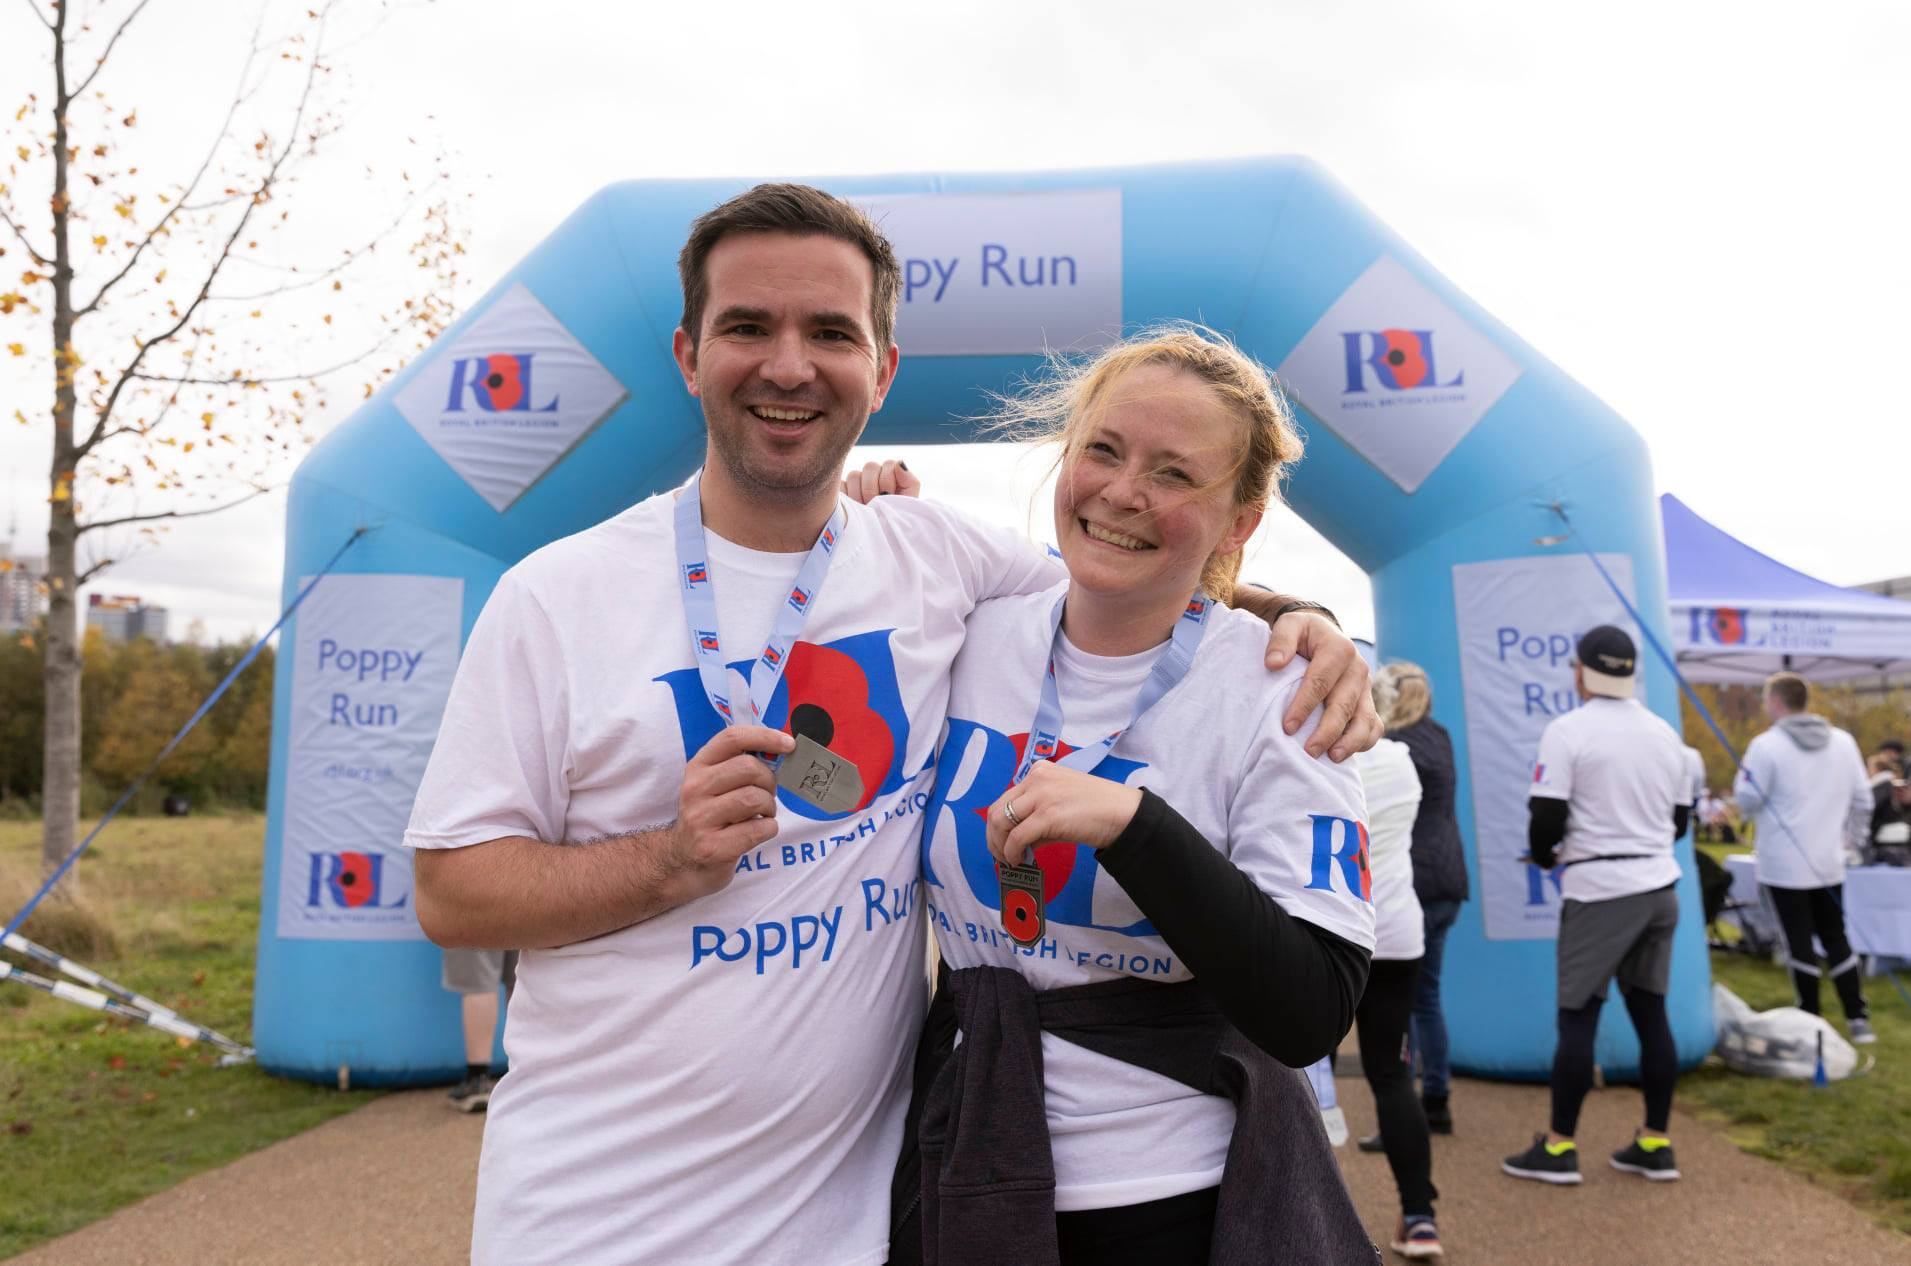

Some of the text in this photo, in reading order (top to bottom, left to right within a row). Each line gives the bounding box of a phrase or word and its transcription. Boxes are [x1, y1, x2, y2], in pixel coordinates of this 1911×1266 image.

[980, 244, 1078, 287] Run
[317, 639, 424, 683] Poppy
[1496, 626, 1585, 667] Pop
[329, 693, 399, 728] Run
